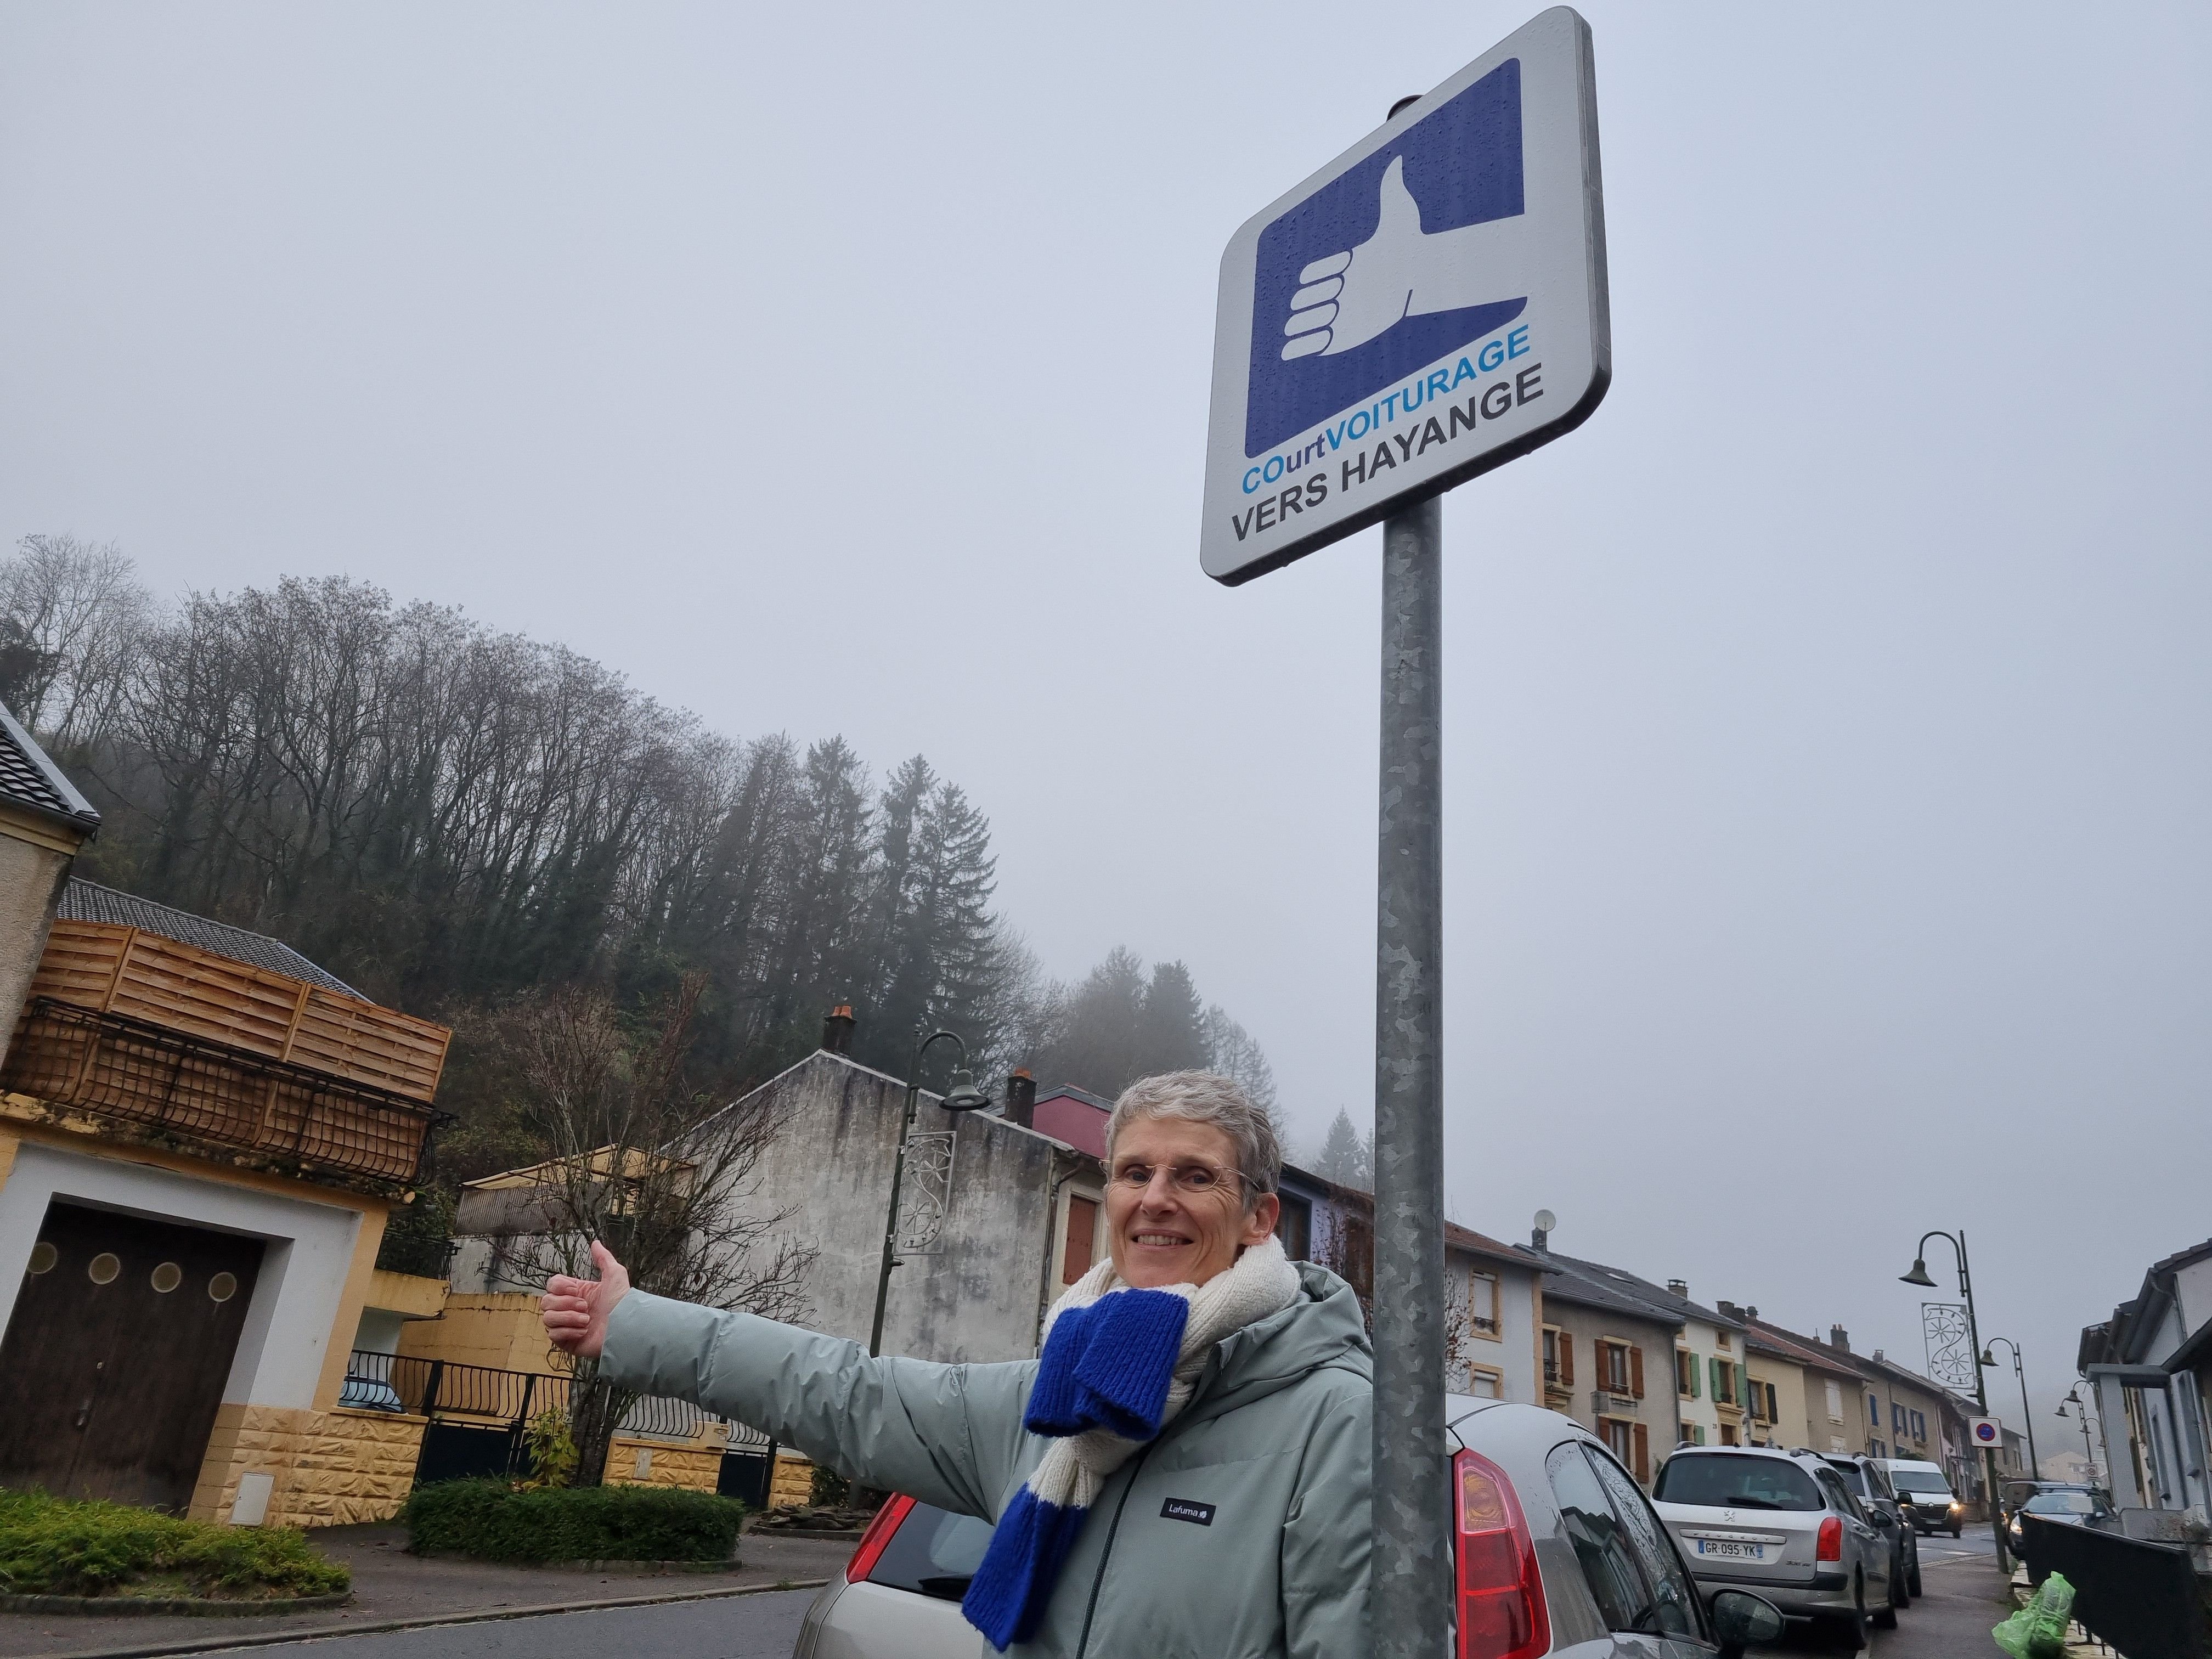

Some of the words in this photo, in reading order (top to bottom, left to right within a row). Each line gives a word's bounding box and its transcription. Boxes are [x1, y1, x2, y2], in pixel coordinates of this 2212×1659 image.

[1231, 472, 1328, 541] VERS
[1341, 362, 1544, 493] HAYANGE
[1169, 1504, 1198, 1516] Lafuma
[1705, 1542, 1756, 1557] GR-095-YK
